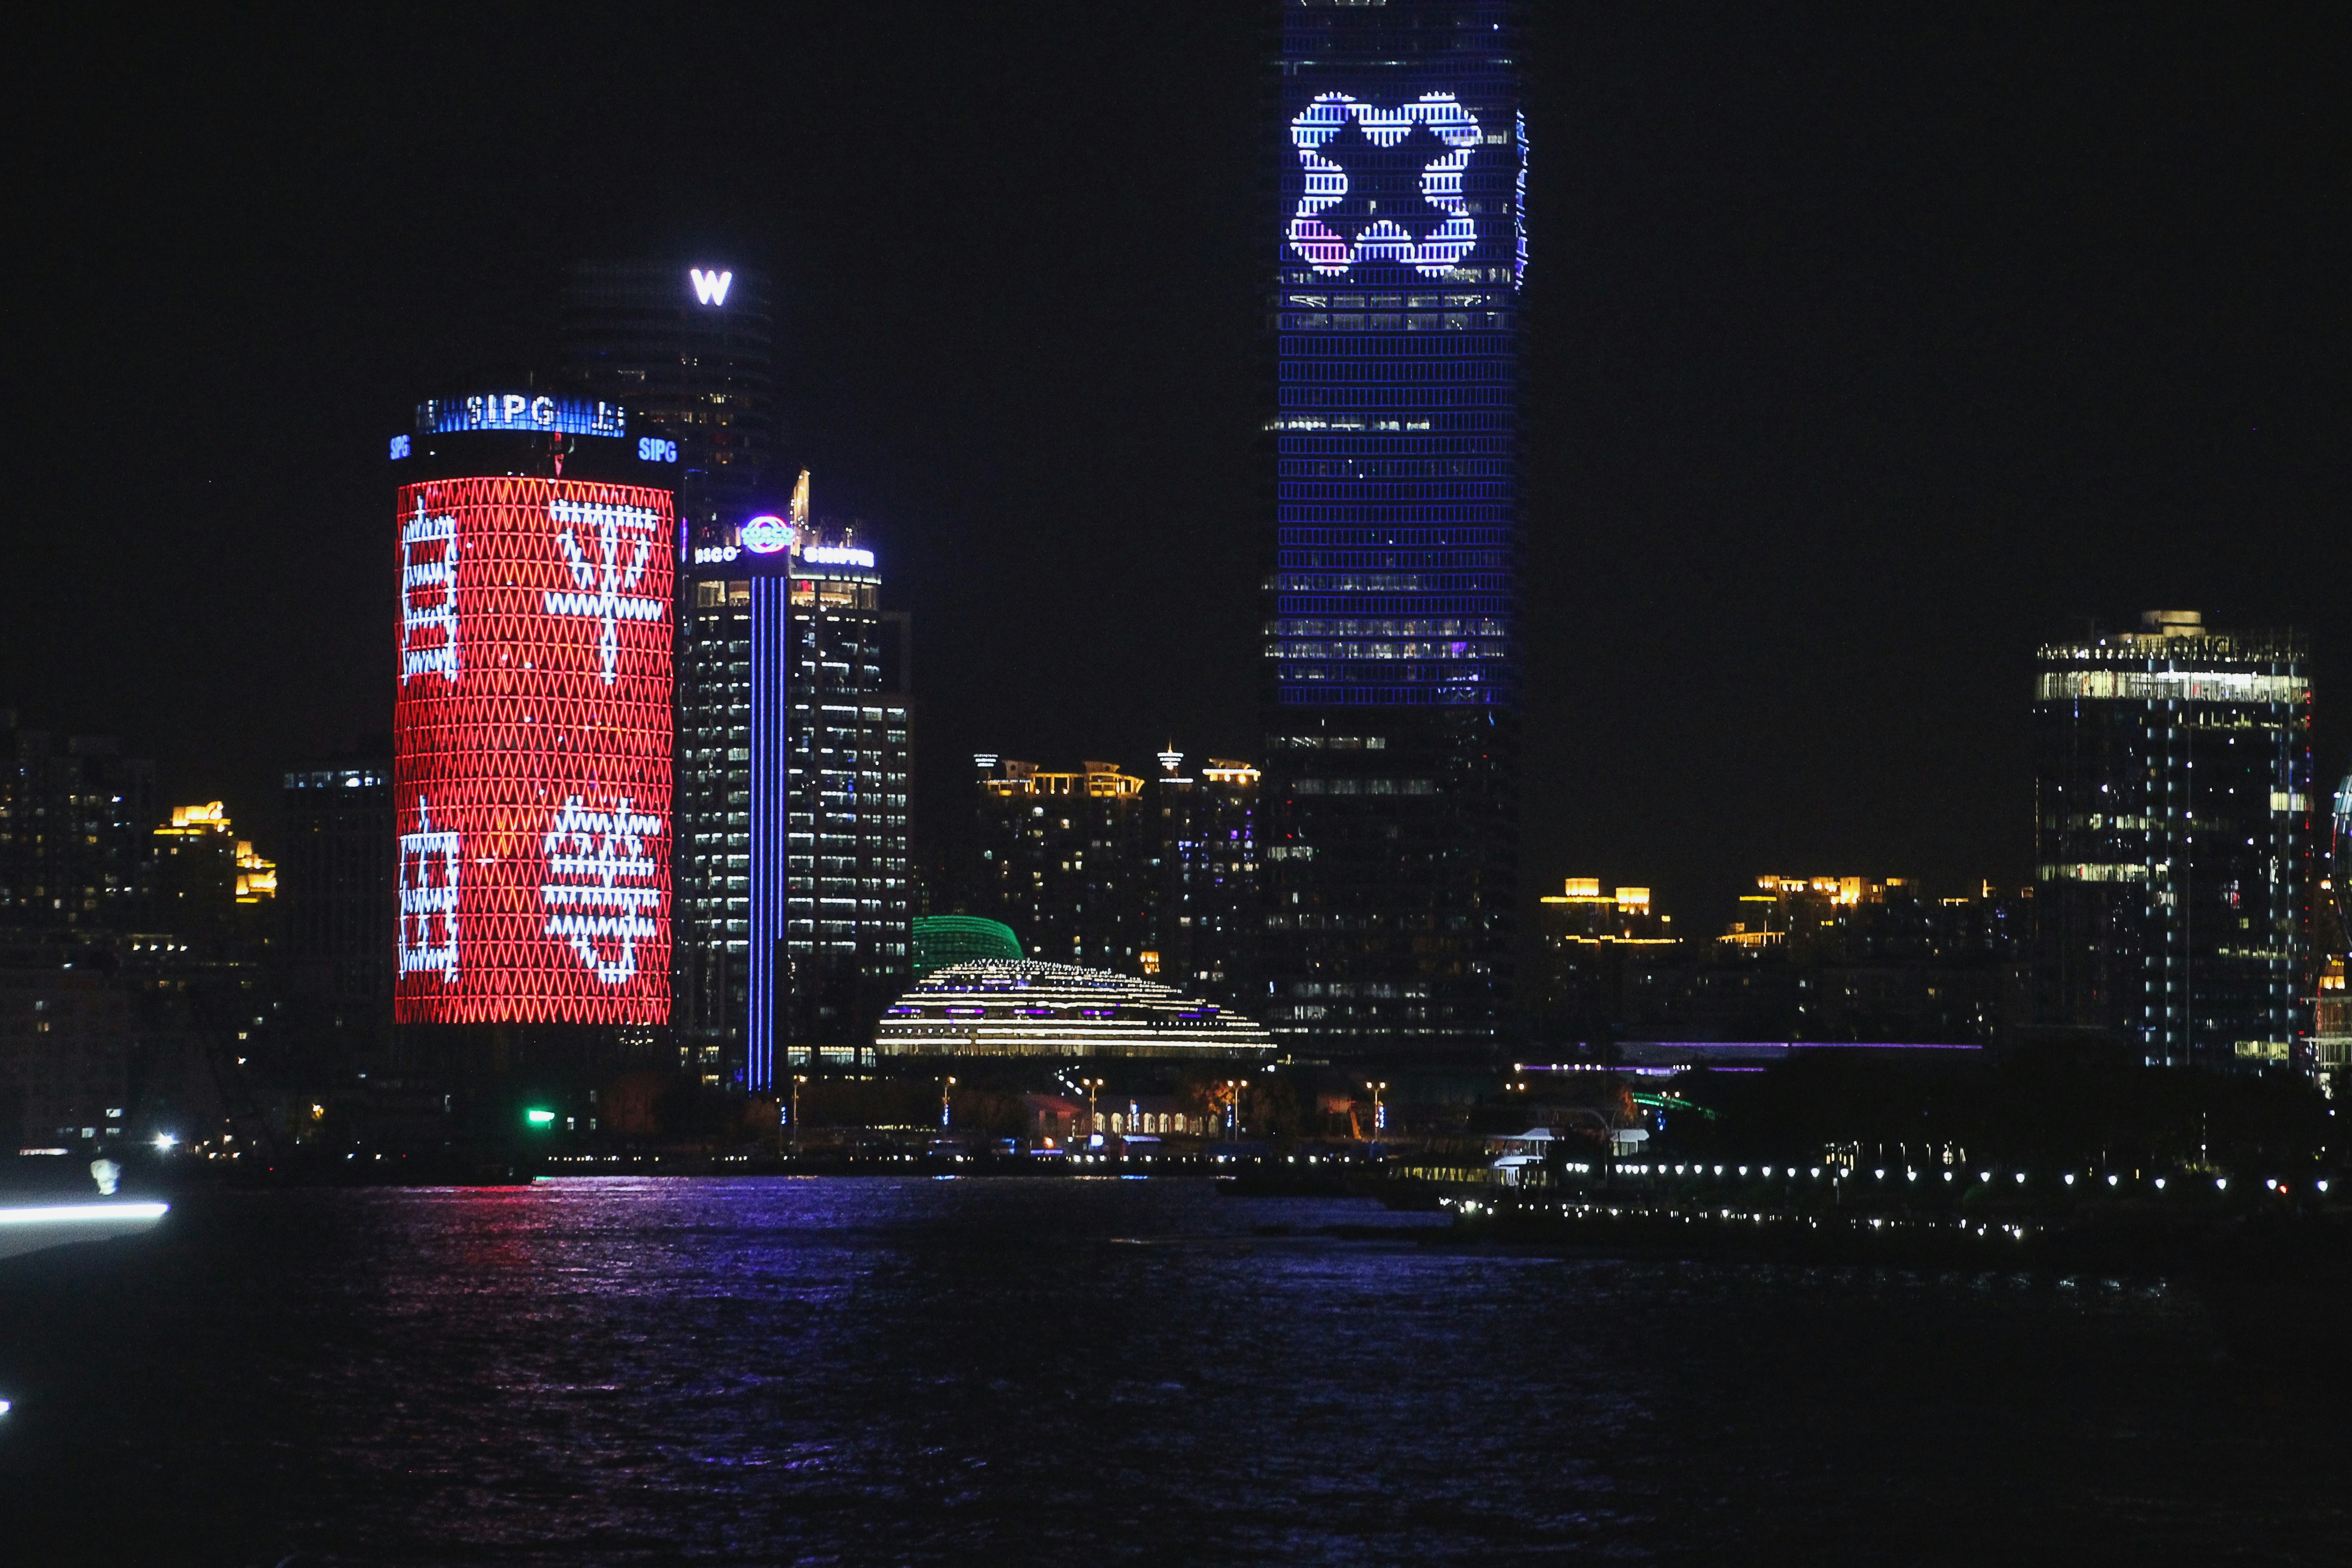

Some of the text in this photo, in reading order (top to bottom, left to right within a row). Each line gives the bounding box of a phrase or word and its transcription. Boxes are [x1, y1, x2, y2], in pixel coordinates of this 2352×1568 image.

[690, 269, 732, 306] W
[467, 394, 554, 425] SIPG
[390, 434, 411, 460] SIPG
[638, 437, 678, 463] SIPG
[741, 526, 794, 538] COSCO
